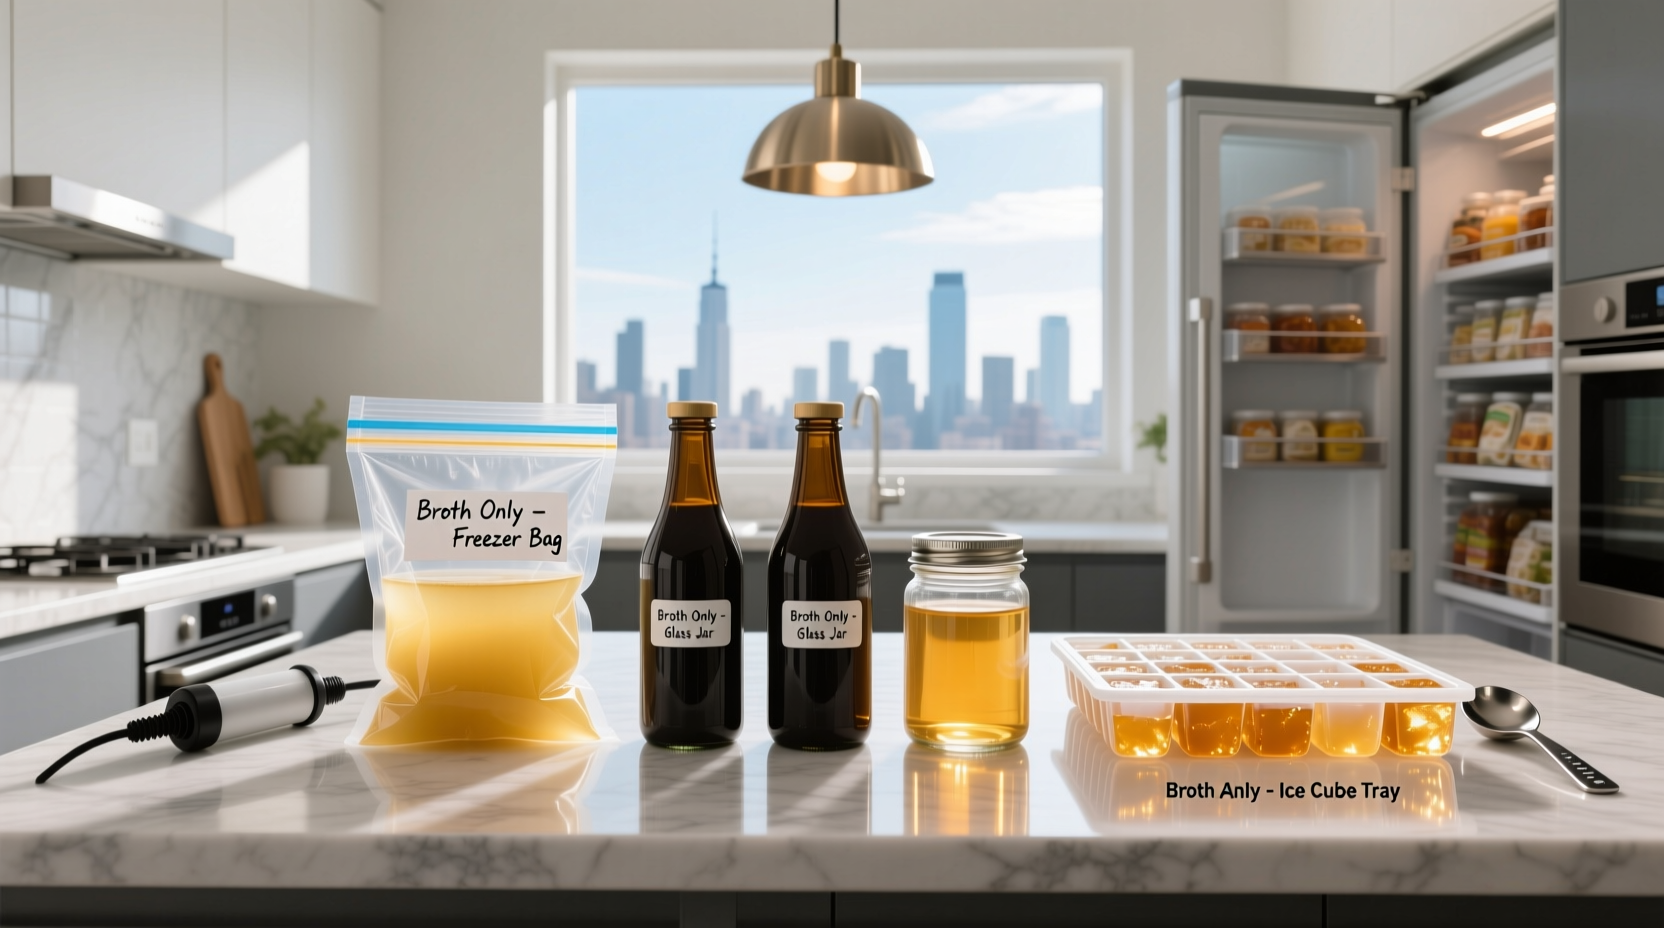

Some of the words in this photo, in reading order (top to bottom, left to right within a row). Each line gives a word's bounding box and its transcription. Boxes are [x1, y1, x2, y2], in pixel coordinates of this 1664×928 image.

[417, 499, 471, 520] Broth
[480, 499, 523, 527] Only
[453, 527, 522, 548] Freezer
[530, 527, 562, 555] Bag
[658, 609, 687, 621] Broth
[692, 609, 717, 625] Only
[791, 610, 820, 622] Broth
[825, 610, 848, 625] Only
[665, 626, 691, 639] Glass
[696, 627, 714, 639] Jar
[797, 626, 825, 640] Glass
[829, 627, 847, 640] Jar
